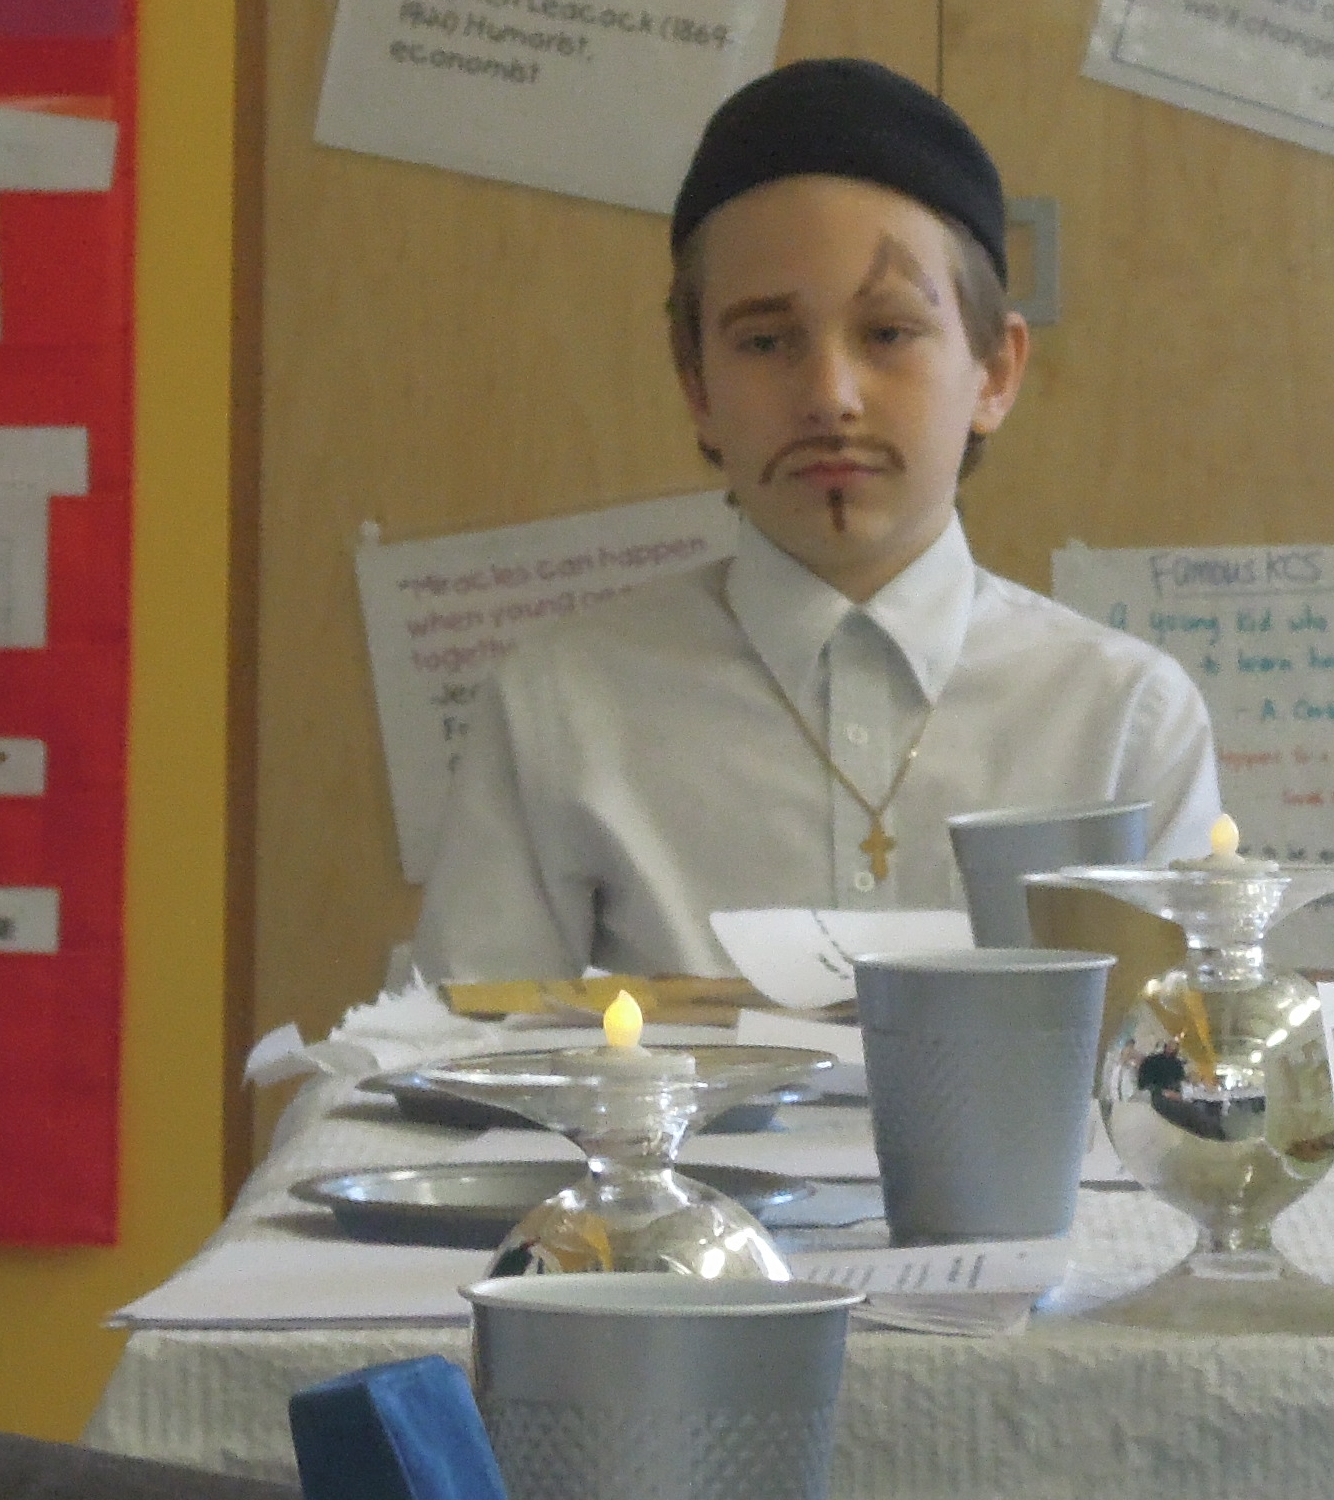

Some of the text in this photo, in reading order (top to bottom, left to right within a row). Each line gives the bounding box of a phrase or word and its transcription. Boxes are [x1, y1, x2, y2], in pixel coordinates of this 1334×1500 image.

[389, 38, 541, 84] economist
[534, 553, 595, 583] can
[598, 535, 707, 569] happen
[1149, 551, 1256, 597] Famous
[1267, 548, 1322, 584] KCS
[406, 608, 484, 639] when
